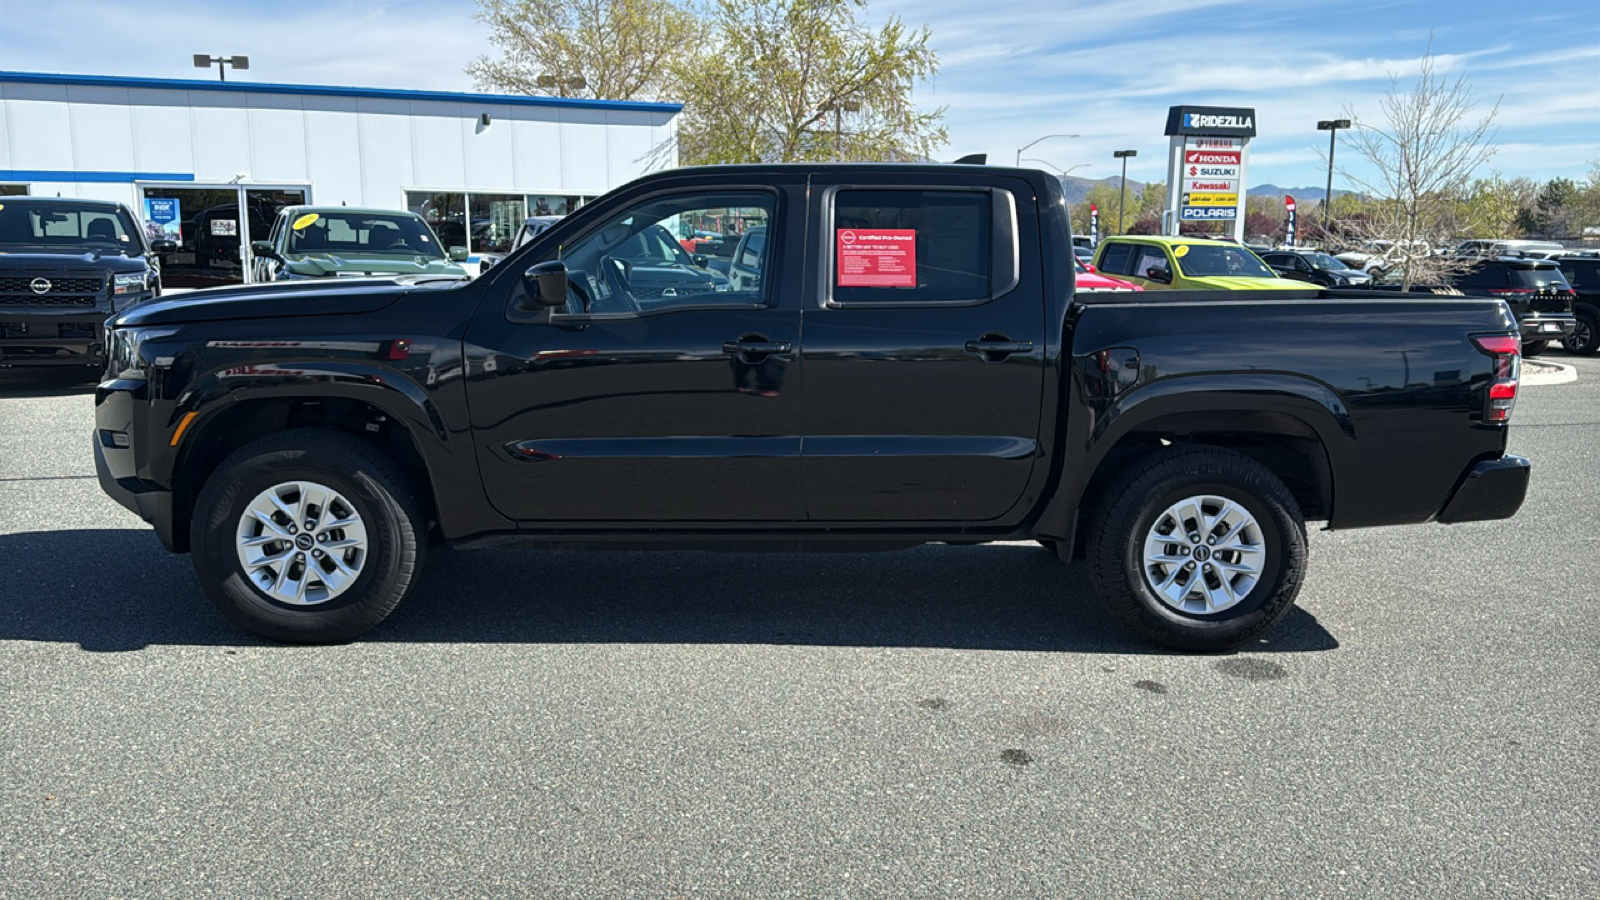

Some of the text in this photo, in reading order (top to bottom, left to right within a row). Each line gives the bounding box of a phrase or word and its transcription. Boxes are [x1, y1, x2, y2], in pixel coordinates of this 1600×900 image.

[1200, 115, 1252, 128] RIDEZILLA
[1205, 139, 1233, 149] YAMAHA
[1199, 155, 1237, 163] HONDA
[1200, 168, 1235, 176] SUZUKI
[1192, 181, 1230, 190] Kawasaki
[1184, 208, 1236, 217] POLARIS
